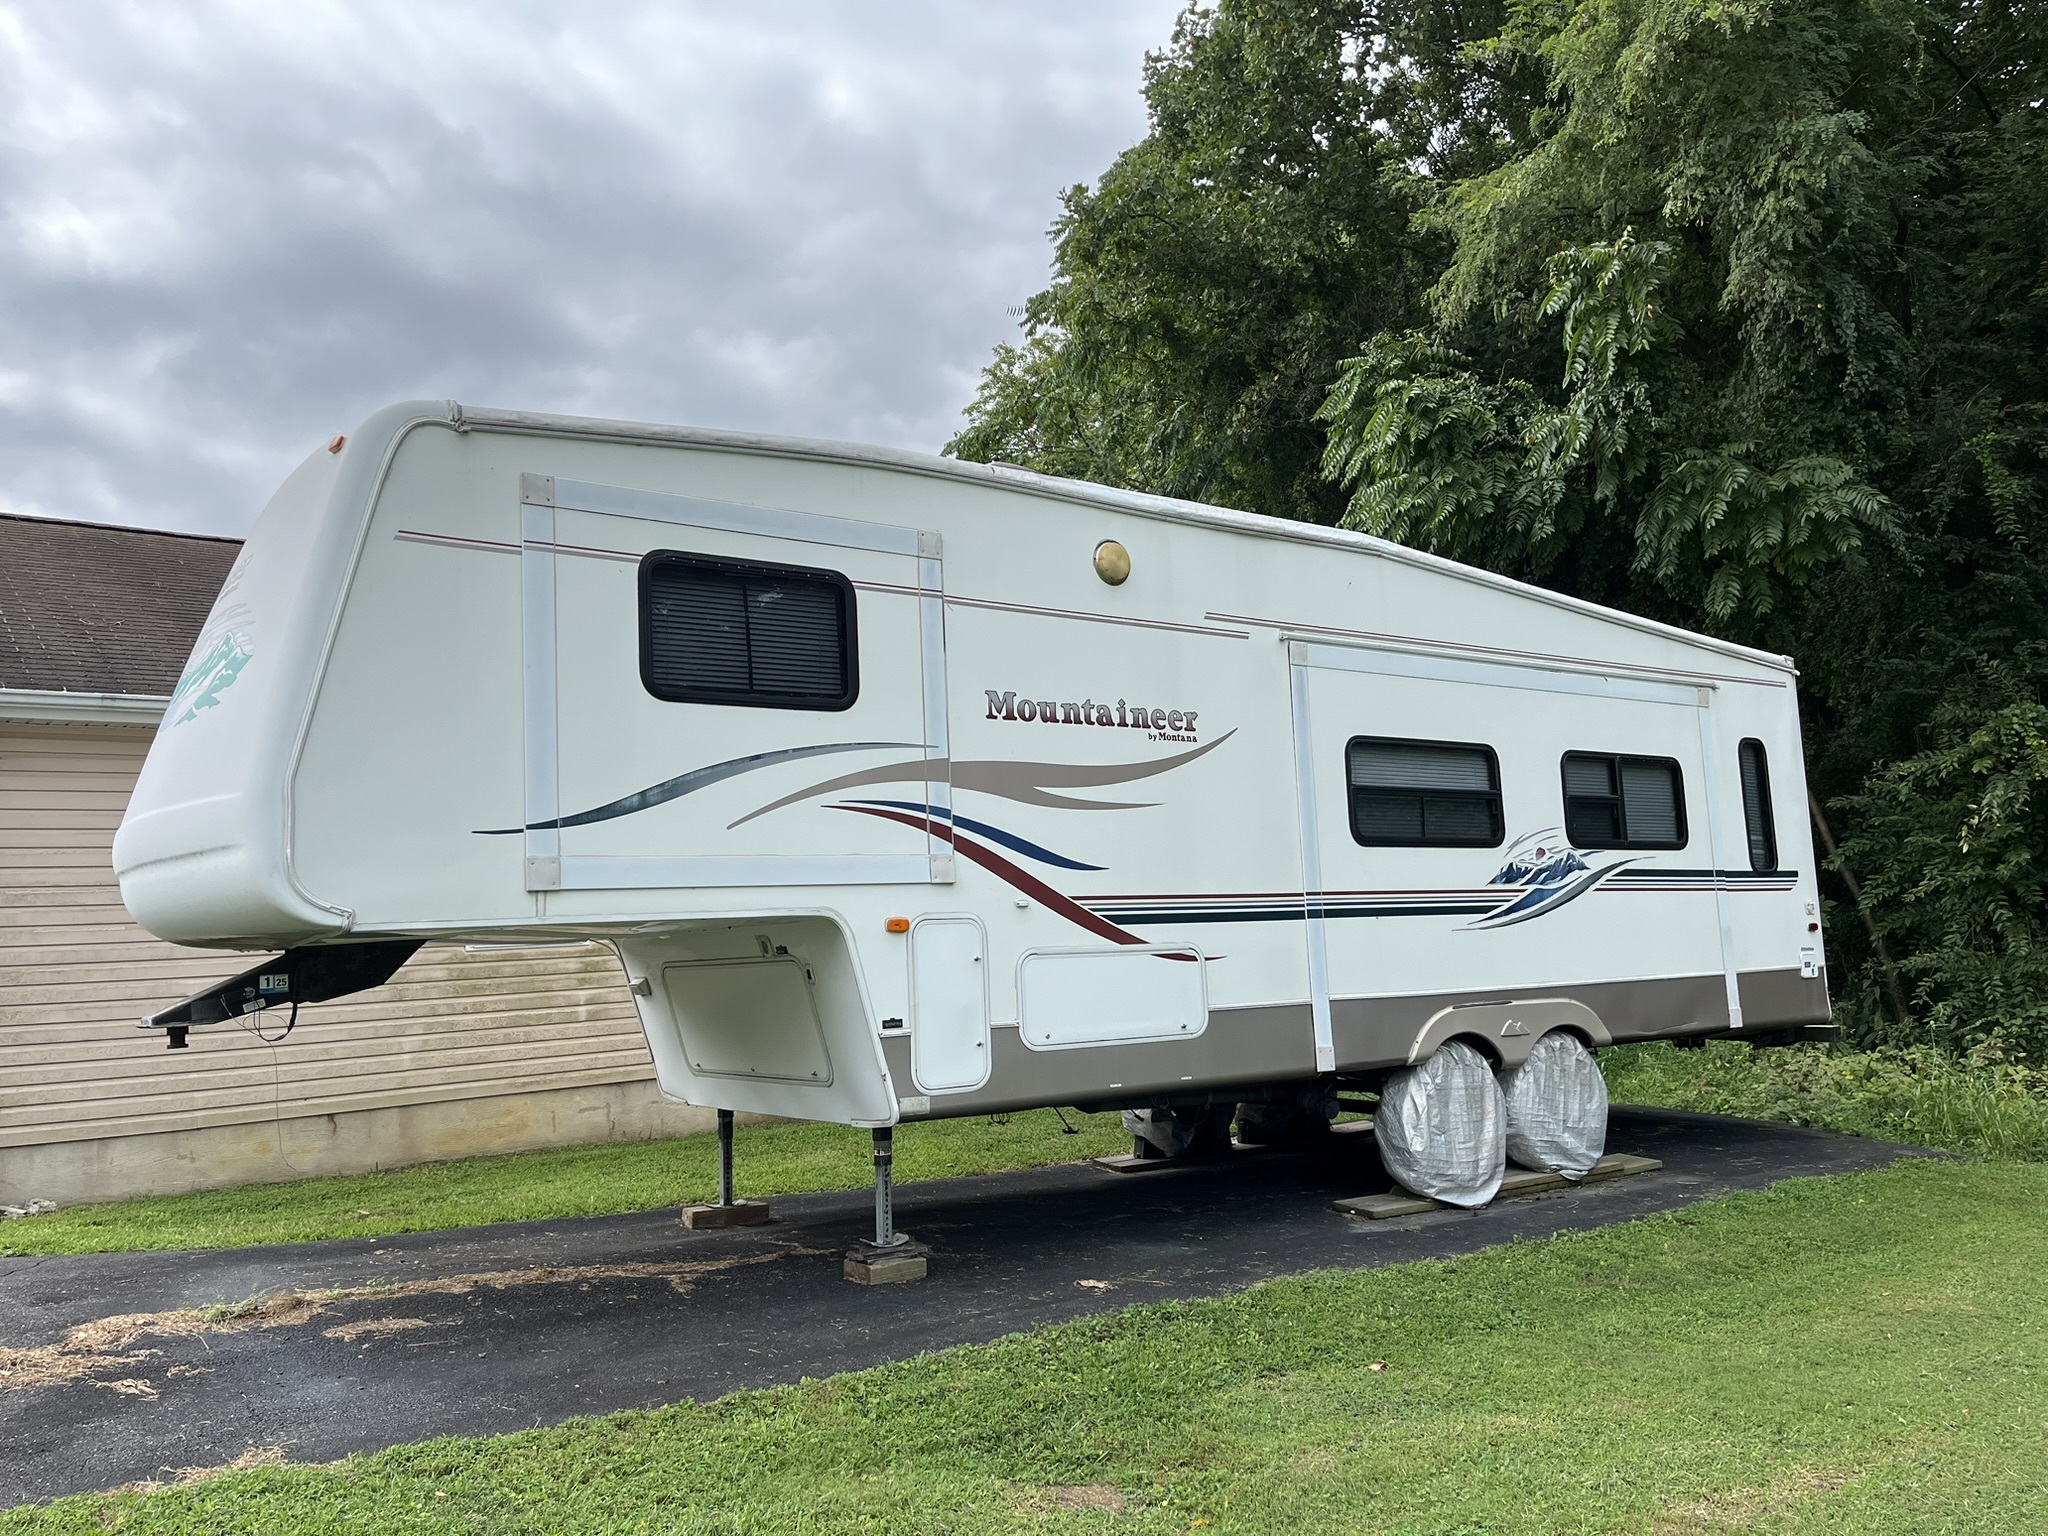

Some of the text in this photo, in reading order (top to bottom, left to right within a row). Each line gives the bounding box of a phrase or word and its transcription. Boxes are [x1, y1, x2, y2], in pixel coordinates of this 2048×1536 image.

[985, 690, 1198, 731] Mountaineer
[1148, 732, 1198, 742] by Montana
[276, 977, 287, 987] 25
